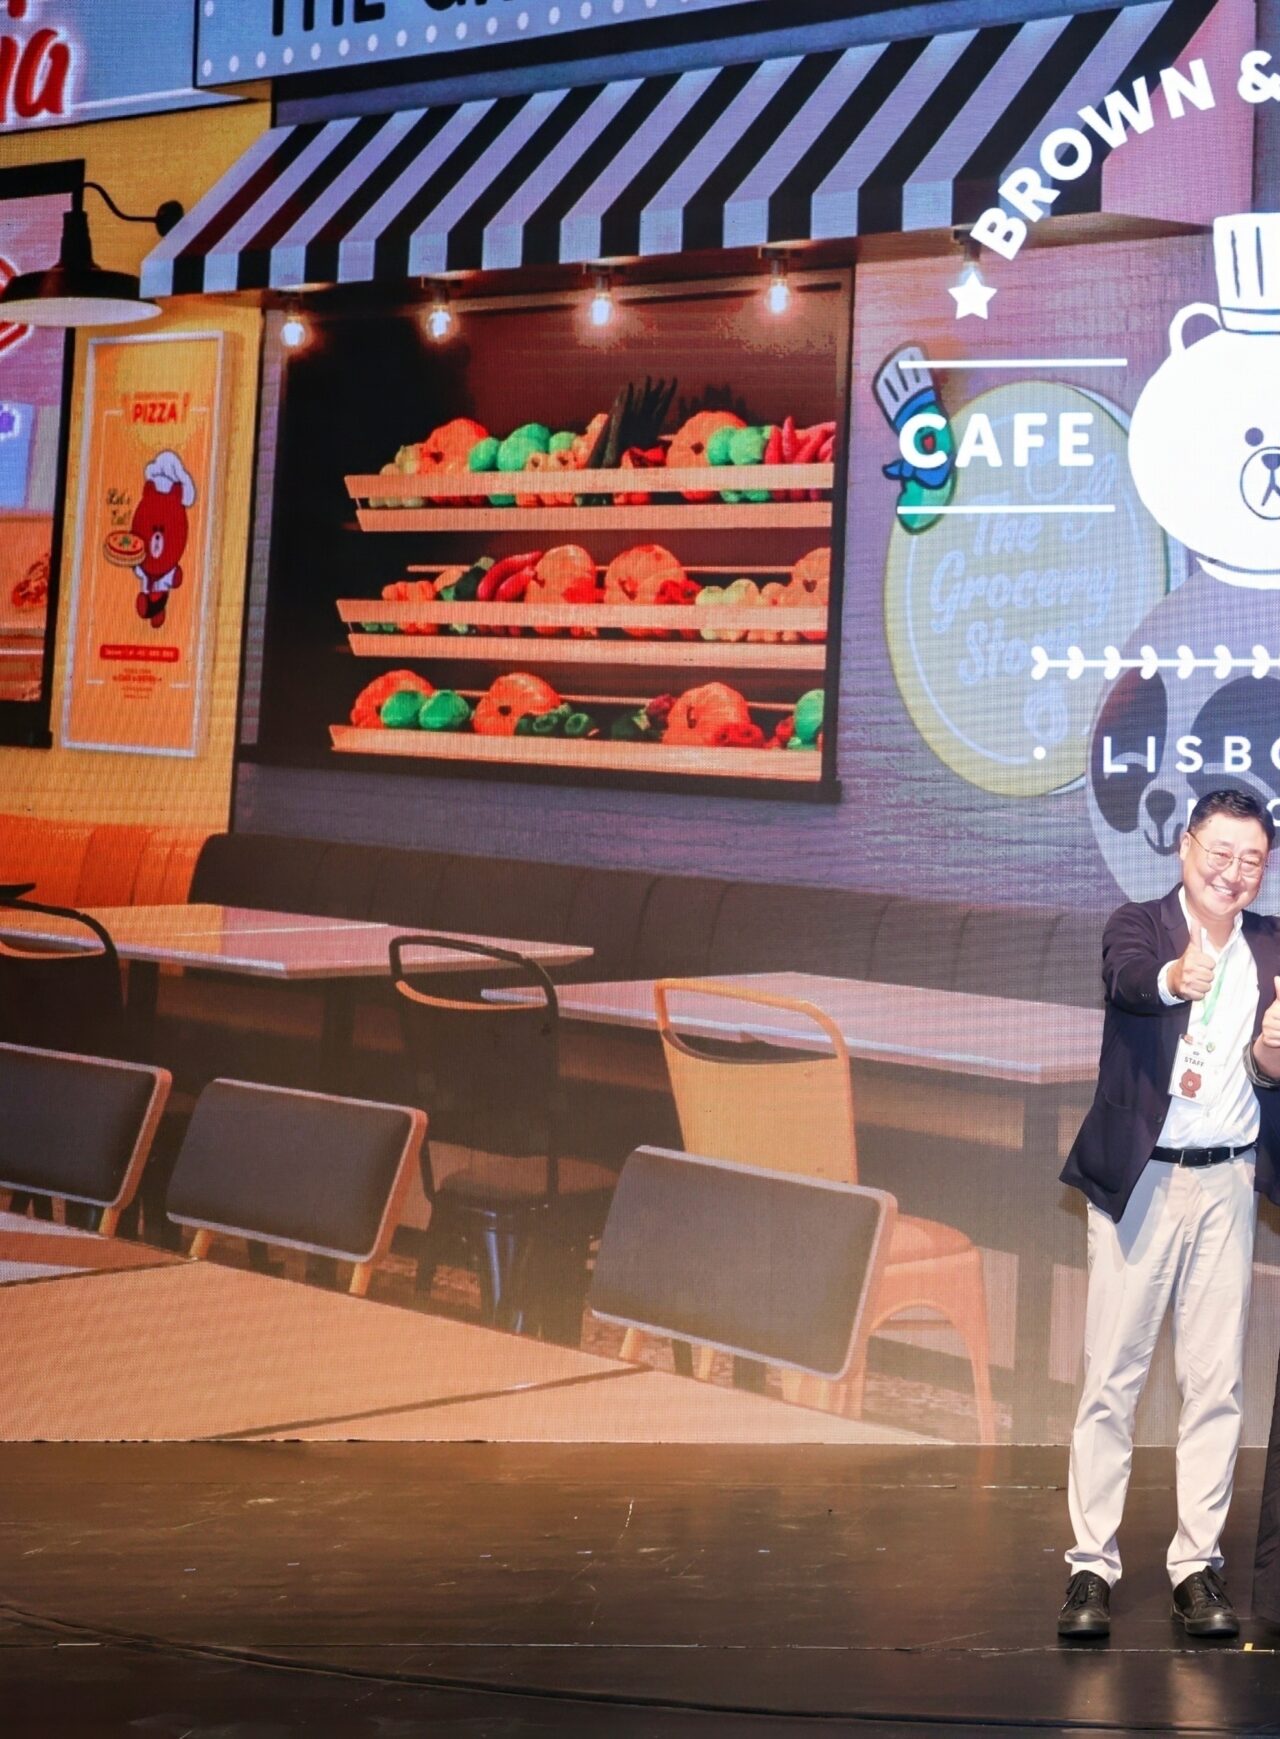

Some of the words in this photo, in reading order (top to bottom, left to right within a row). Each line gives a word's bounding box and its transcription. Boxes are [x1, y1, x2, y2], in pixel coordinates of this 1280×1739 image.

[969, 58, 1217, 261] BROWN
[132, 402, 178, 424] PIZZA
[898, 411, 1095, 469] CAFE
[962, 489, 1043, 556] The
[929, 550, 1118, 634] Grocery
[1184, 1056, 1205, 1067] STAFF
